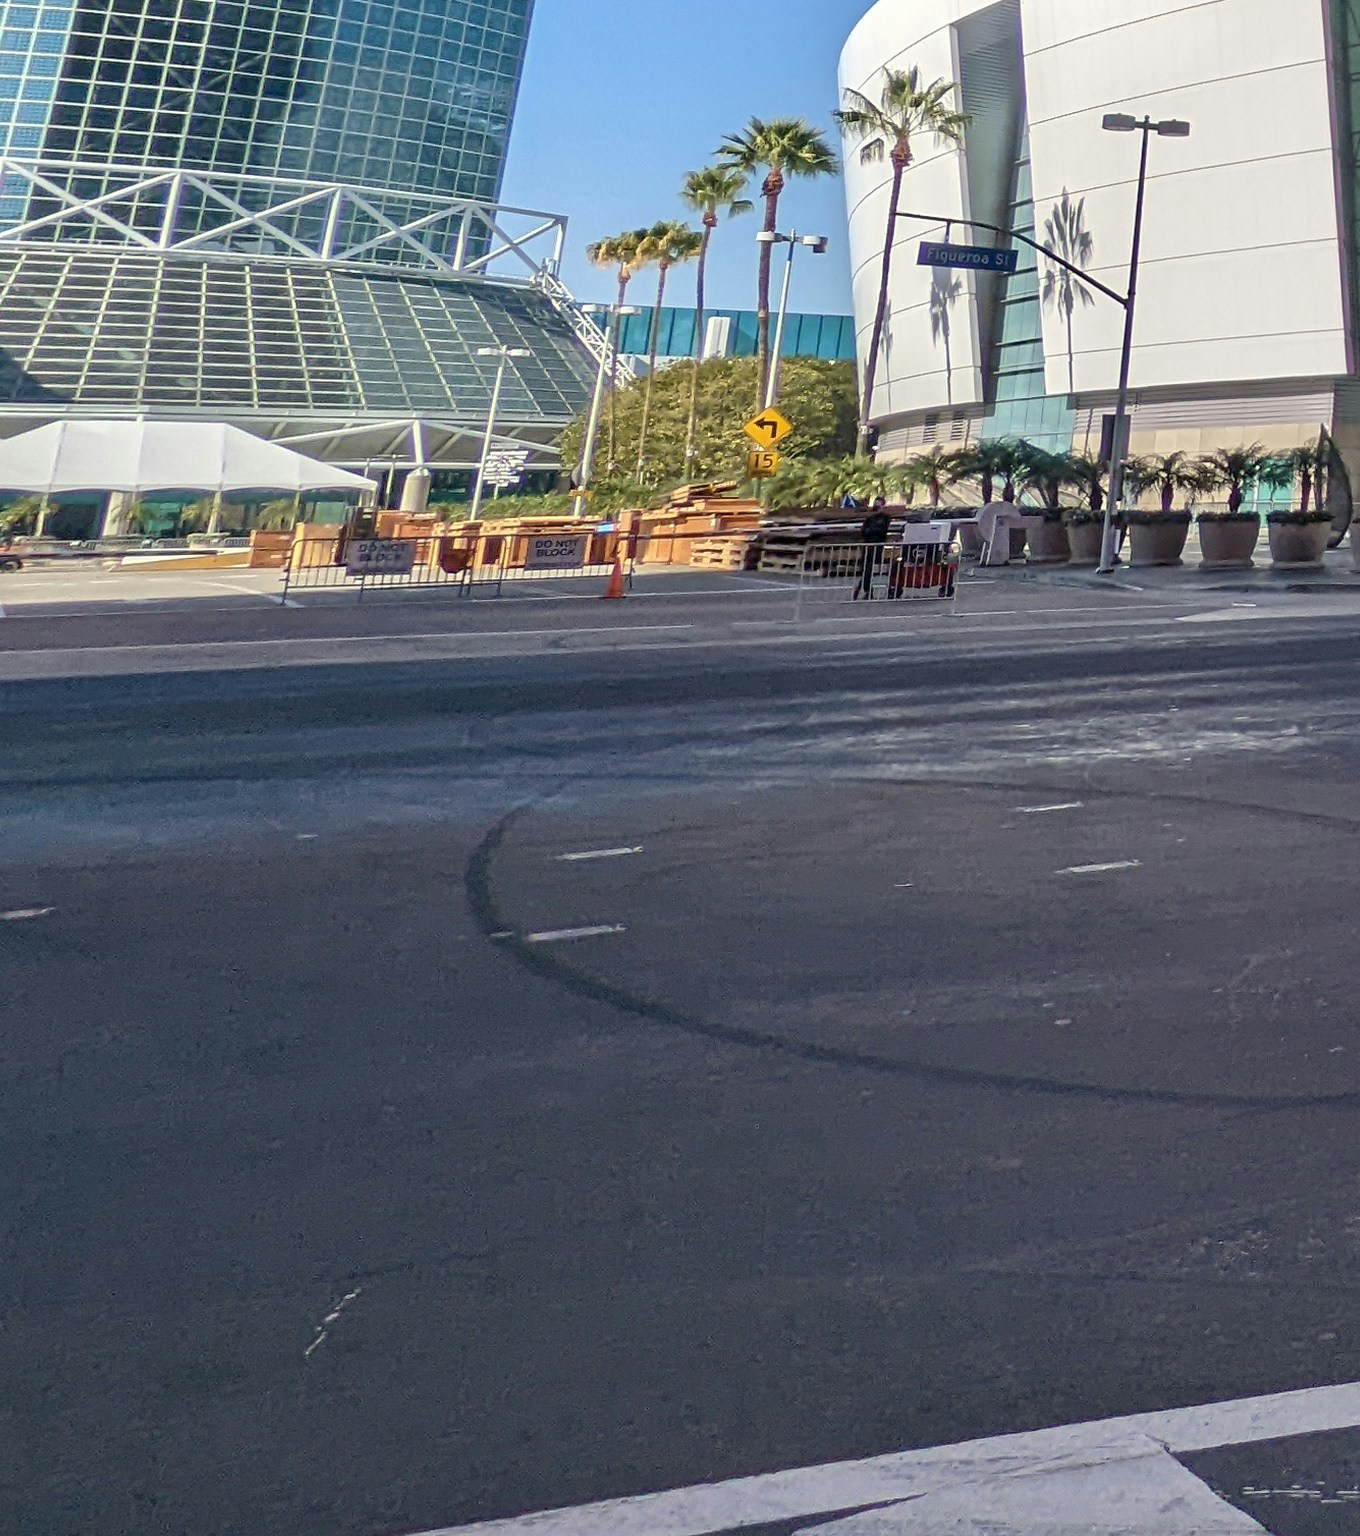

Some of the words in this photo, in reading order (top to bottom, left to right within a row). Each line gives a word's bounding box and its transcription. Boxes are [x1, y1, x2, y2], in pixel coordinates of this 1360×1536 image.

[927, 248, 989, 263] Figueroa
[995, 253, 1009, 266] St
[754, 454, 773, 468] 15
[535, 540, 553, 549] DO
[556, 539, 578, 548] NOT
[537, 548, 575, 557] BLOCK
